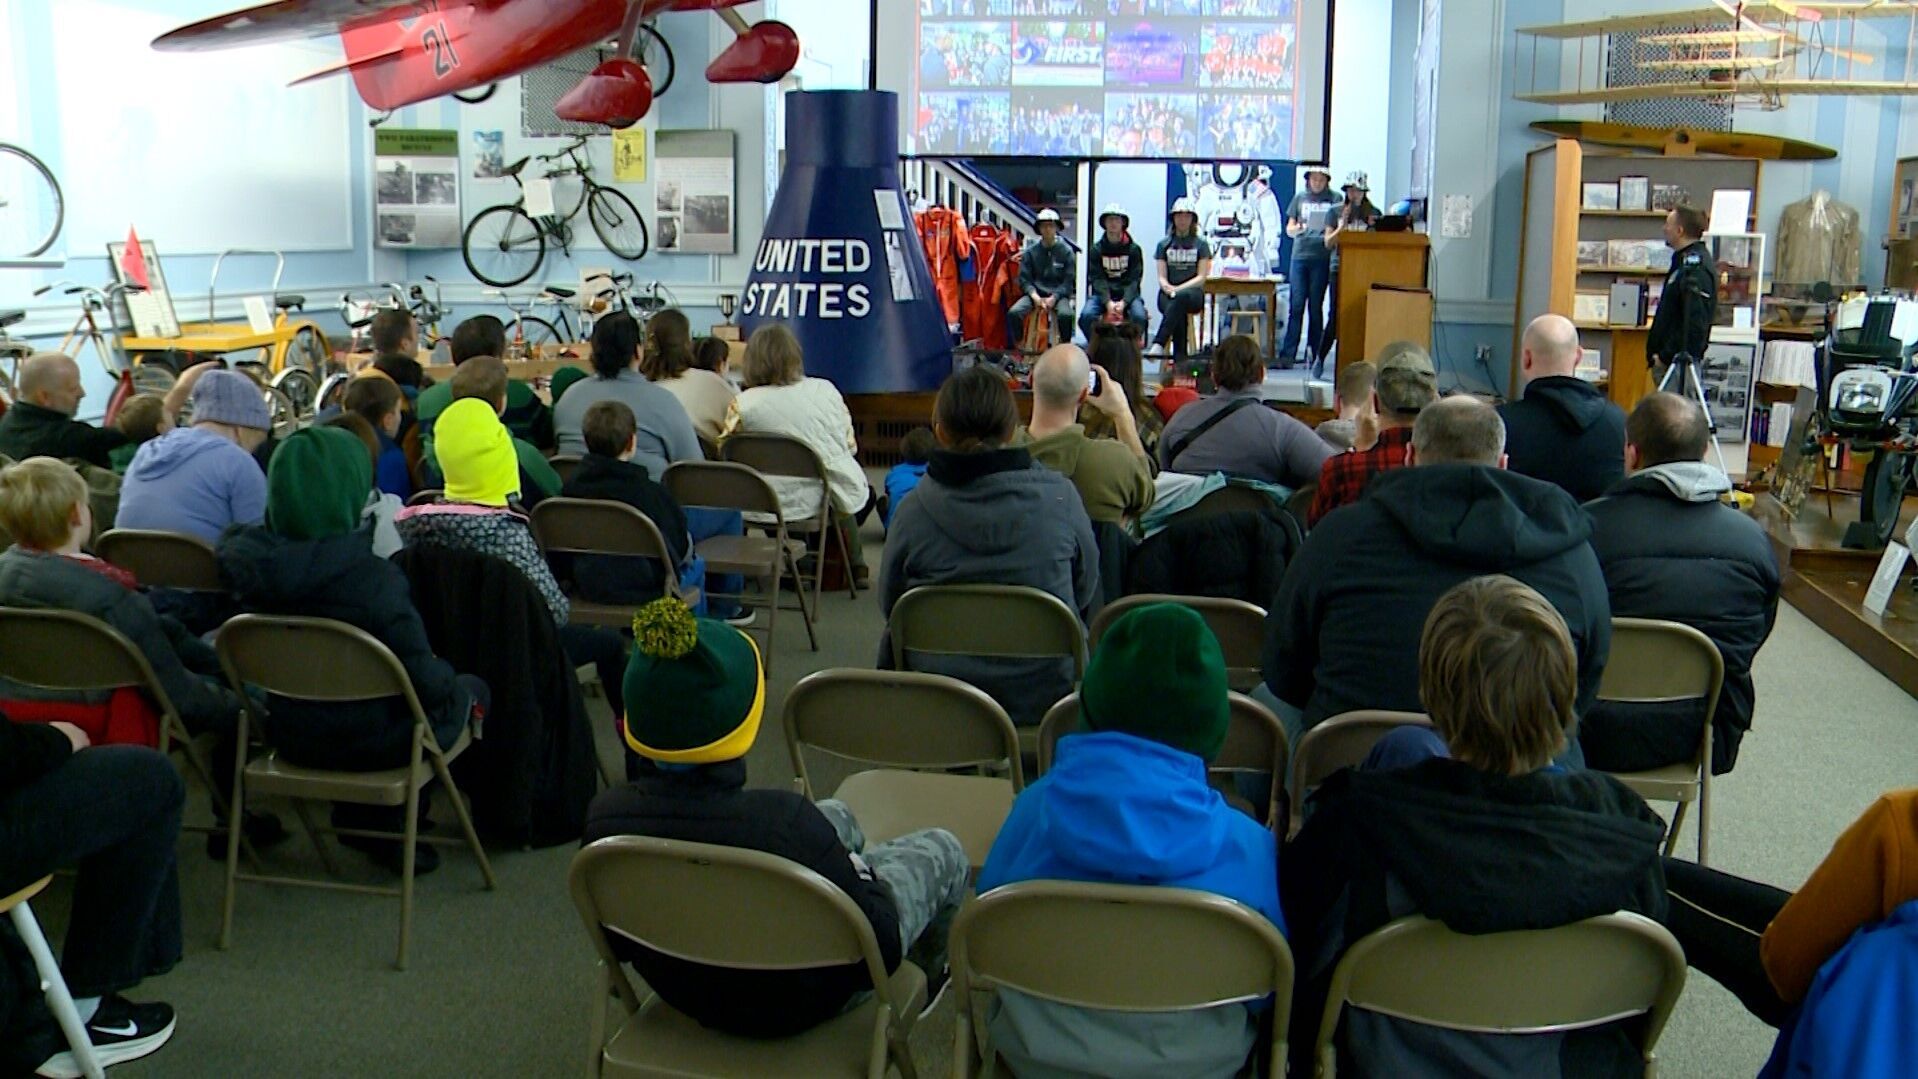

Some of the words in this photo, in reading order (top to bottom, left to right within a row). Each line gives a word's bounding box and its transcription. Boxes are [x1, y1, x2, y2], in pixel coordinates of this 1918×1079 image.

[423, 20, 459, 77] 21
[755, 239, 871, 272] UNITED
[743, 283, 871, 318] STATES
